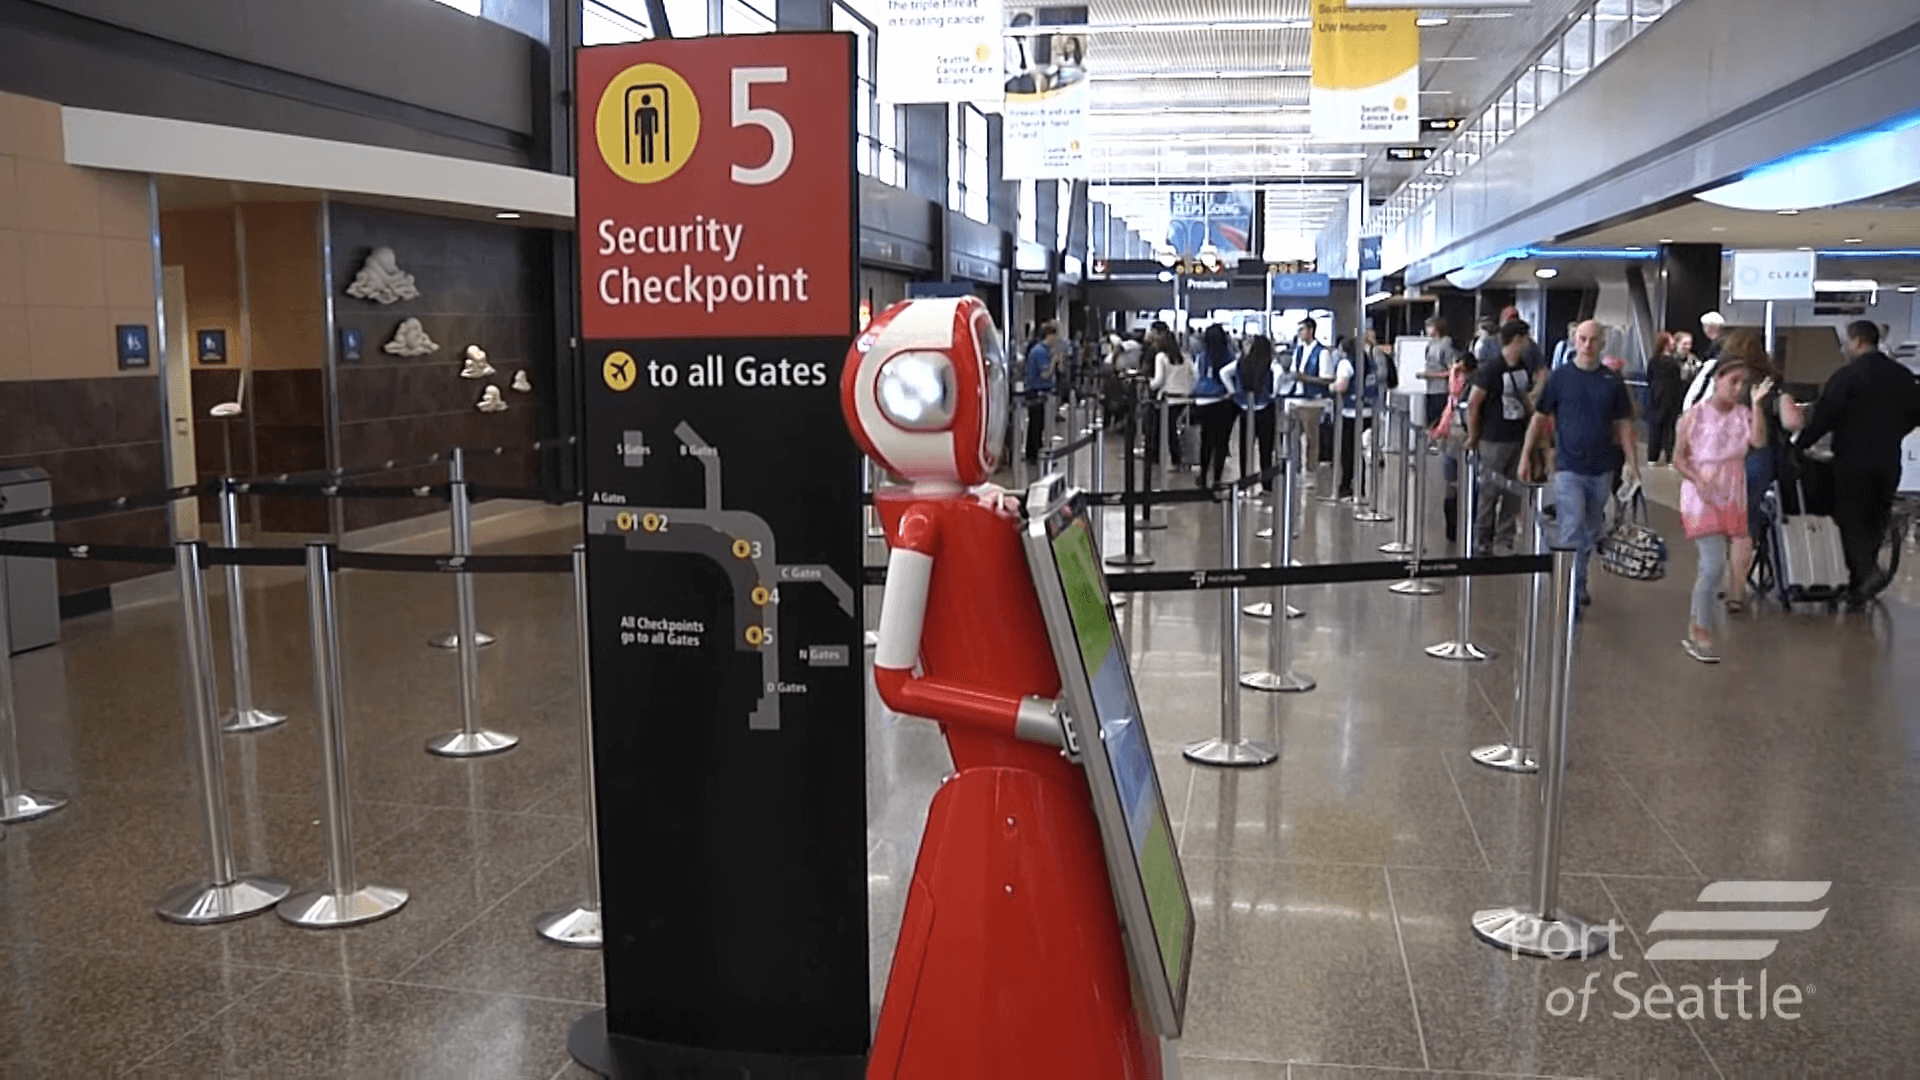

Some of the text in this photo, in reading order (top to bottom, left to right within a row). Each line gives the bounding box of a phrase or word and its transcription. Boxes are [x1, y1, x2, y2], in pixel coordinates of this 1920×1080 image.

[1340, 22, 1388, 32] Medicine
[936, 65, 993, 74] Cancer Care
[1361, 105, 1390, 113] Seattle
[1360, 113, 1409, 121] Cancer Care
[730, 66, 795, 185] 5
[1360, 123, 1393, 131] Alliance
[598, 214, 744, 262] Security
[1768, 271, 1809, 279] CLEAR
[599, 264, 808, 313] Checkpoint
[1187, 278, 1228, 289] Premium
[648, 355, 827, 386] to all Gates
[617, 444, 651, 455] S Gates
[680, 444, 718, 456] B Gates
[593, 492, 626, 503] A Gates
[632, 514, 639, 530] 1
[658, 515, 668, 532] 2
[751, 542, 762, 558] 3
[781, 567, 822, 578] C Gates
[769, 588, 780, 604] 4
[621, 616, 704, 633] All Checkpoints
[621, 632, 700, 646] go to all Gates
[762, 628, 773, 644] 5
[800, 649, 840, 660] N Gates
[767, 682, 807, 693] D Gates
